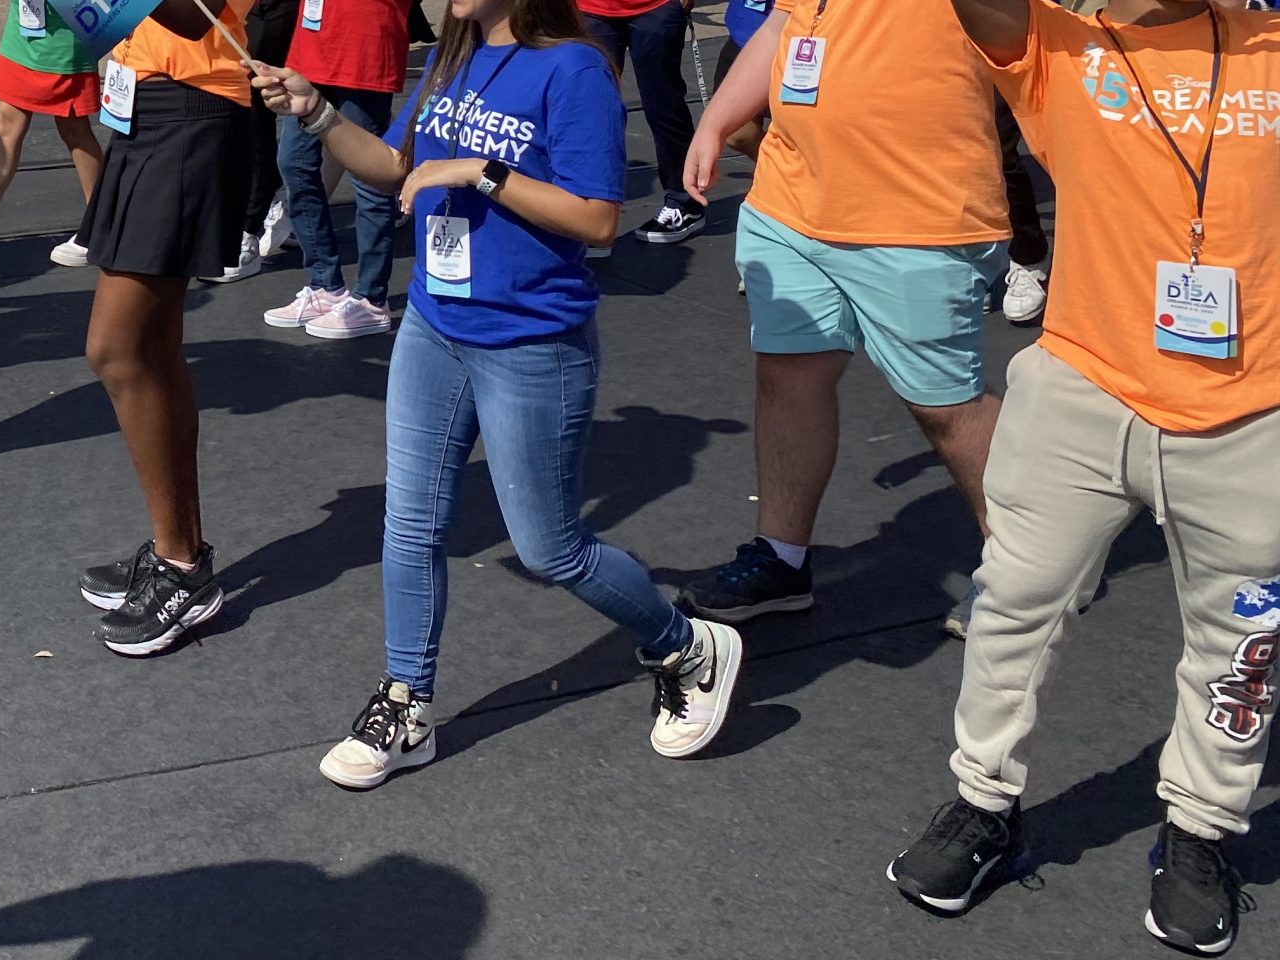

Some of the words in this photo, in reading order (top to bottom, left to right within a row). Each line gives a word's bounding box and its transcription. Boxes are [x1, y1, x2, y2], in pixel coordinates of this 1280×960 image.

[1130, 86, 1280, 113] REAMER
[432, 96, 536, 142] DREAMERS
[1128, 108, 1280, 138] ACADEM
[424, 115, 530, 163] ACDEMY
